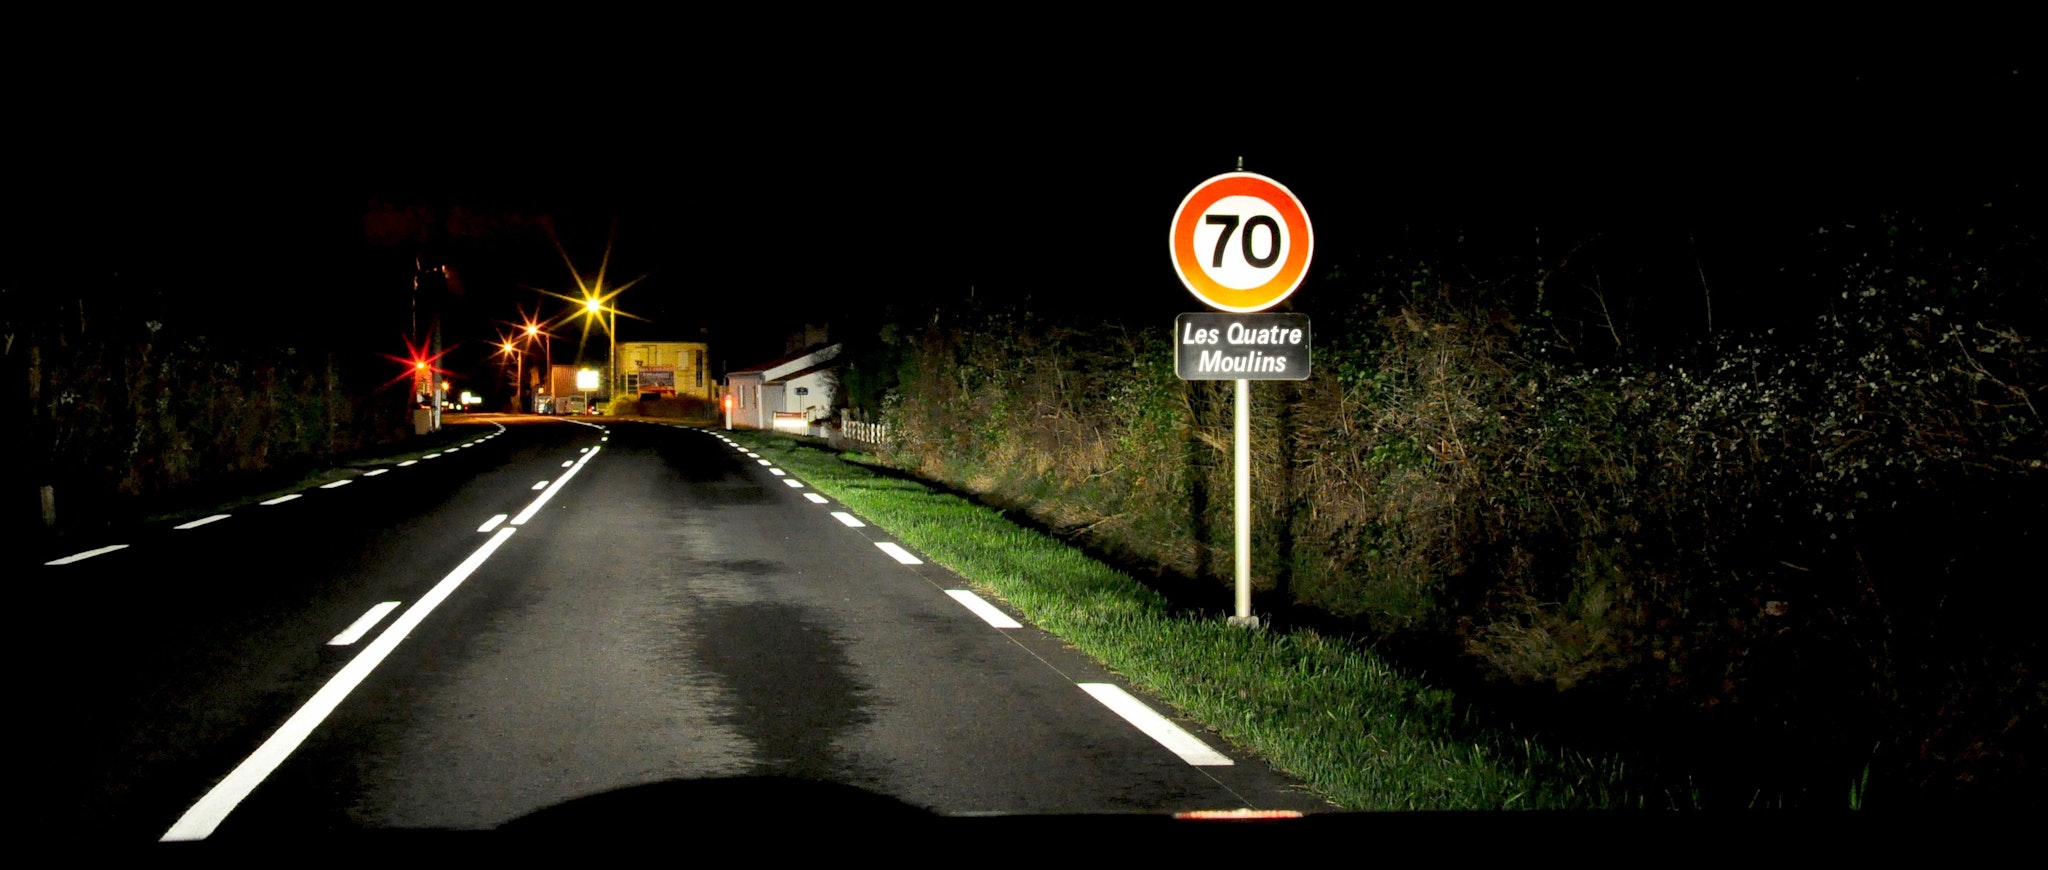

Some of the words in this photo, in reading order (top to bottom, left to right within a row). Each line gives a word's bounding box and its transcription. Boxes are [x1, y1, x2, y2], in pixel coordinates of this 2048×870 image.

[1205, 214, 1281, 269] 70
[1183, 322, 1220, 345] Les
[1227, 322, 1302, 345] Quatre
[1199, 350, 1287, 373] Moulins
